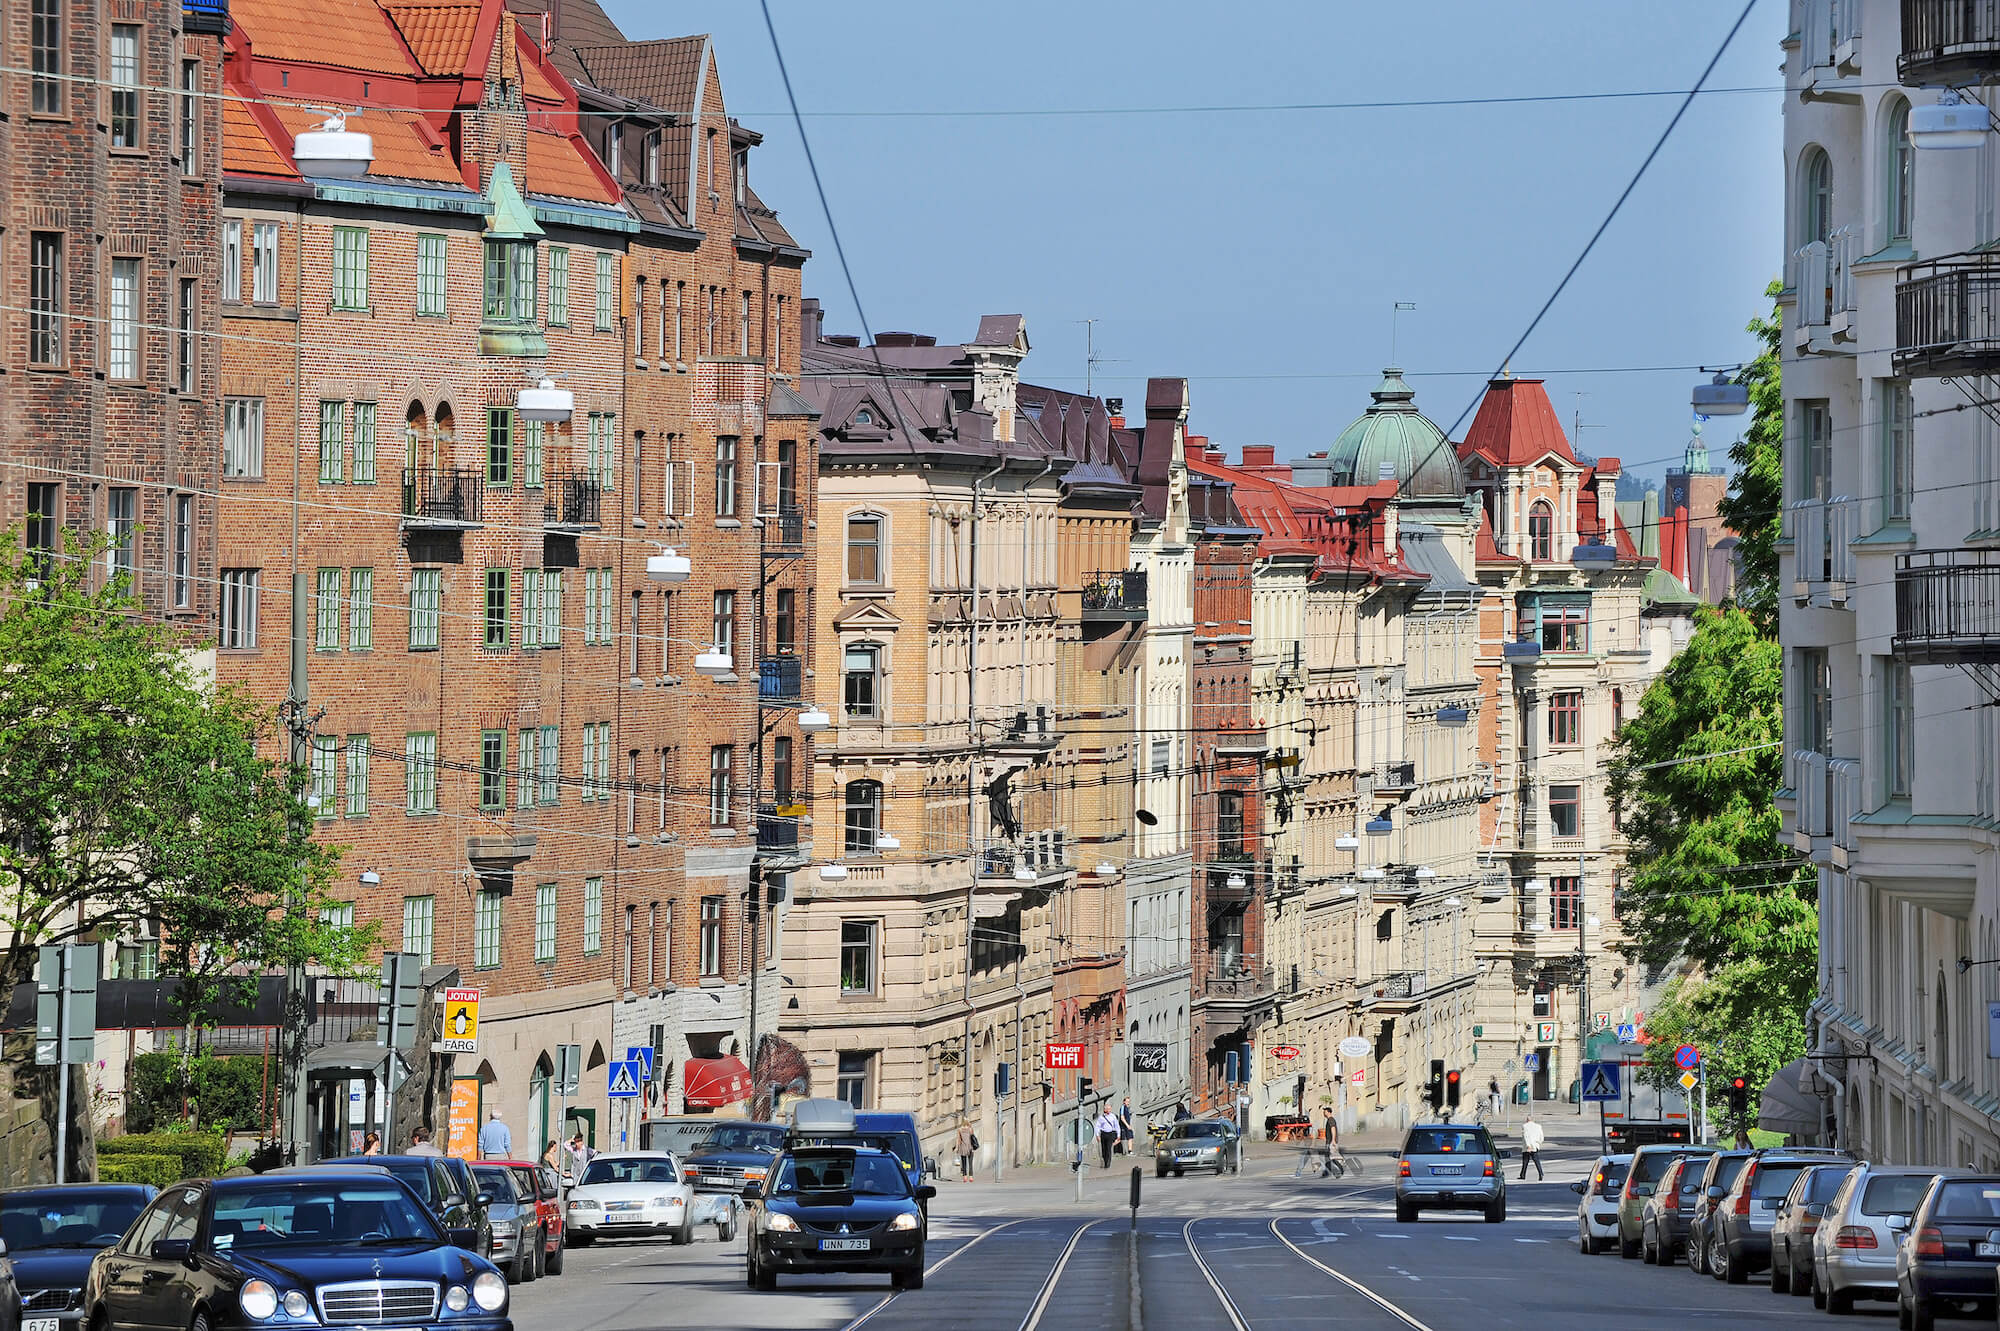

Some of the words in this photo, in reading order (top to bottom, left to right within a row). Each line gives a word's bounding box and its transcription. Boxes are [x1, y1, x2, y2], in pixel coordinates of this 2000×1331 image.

[447, 992, 478, 1001] JOTUN
[1051, 1053, 1078, 1066] HIFI
[824, 1240, 843, 1249] UNN
[849, 1240, 868, 1249] 735
[29, 1320, 57, 1331] 675
